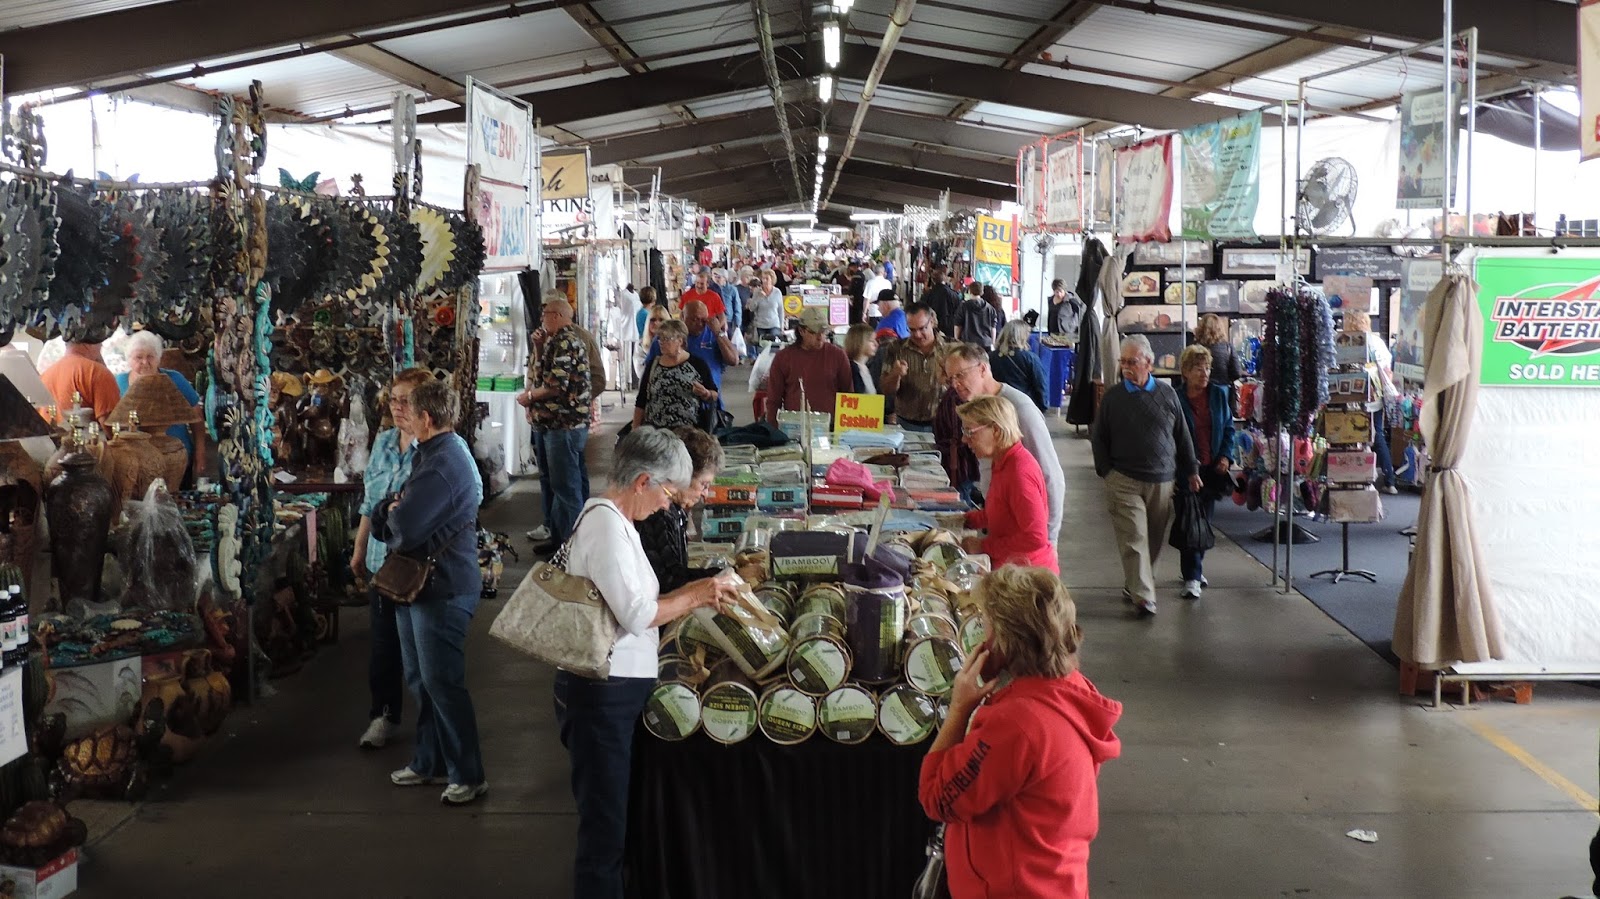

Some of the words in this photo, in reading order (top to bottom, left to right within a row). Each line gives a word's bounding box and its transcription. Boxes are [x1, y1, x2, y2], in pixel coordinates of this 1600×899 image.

[499, 122, 518, 161] BUY
[983, 222, 1012, 242] BU
[1500, 323, 1600, 337] BATTERI
[1509, 364, 1565, 380] SOLD
[841, 395, 859, 409] Pay
[840, 414, 879, 428] Cashier
[709, 702, 724, 710] SIZE
[724, 703, 749, 711] QUEEN
[832, 704, 864, 712] BAMBOO
[768, 716, 791, 728] QUEEN
[792, 722, 807, 732] SIZE
